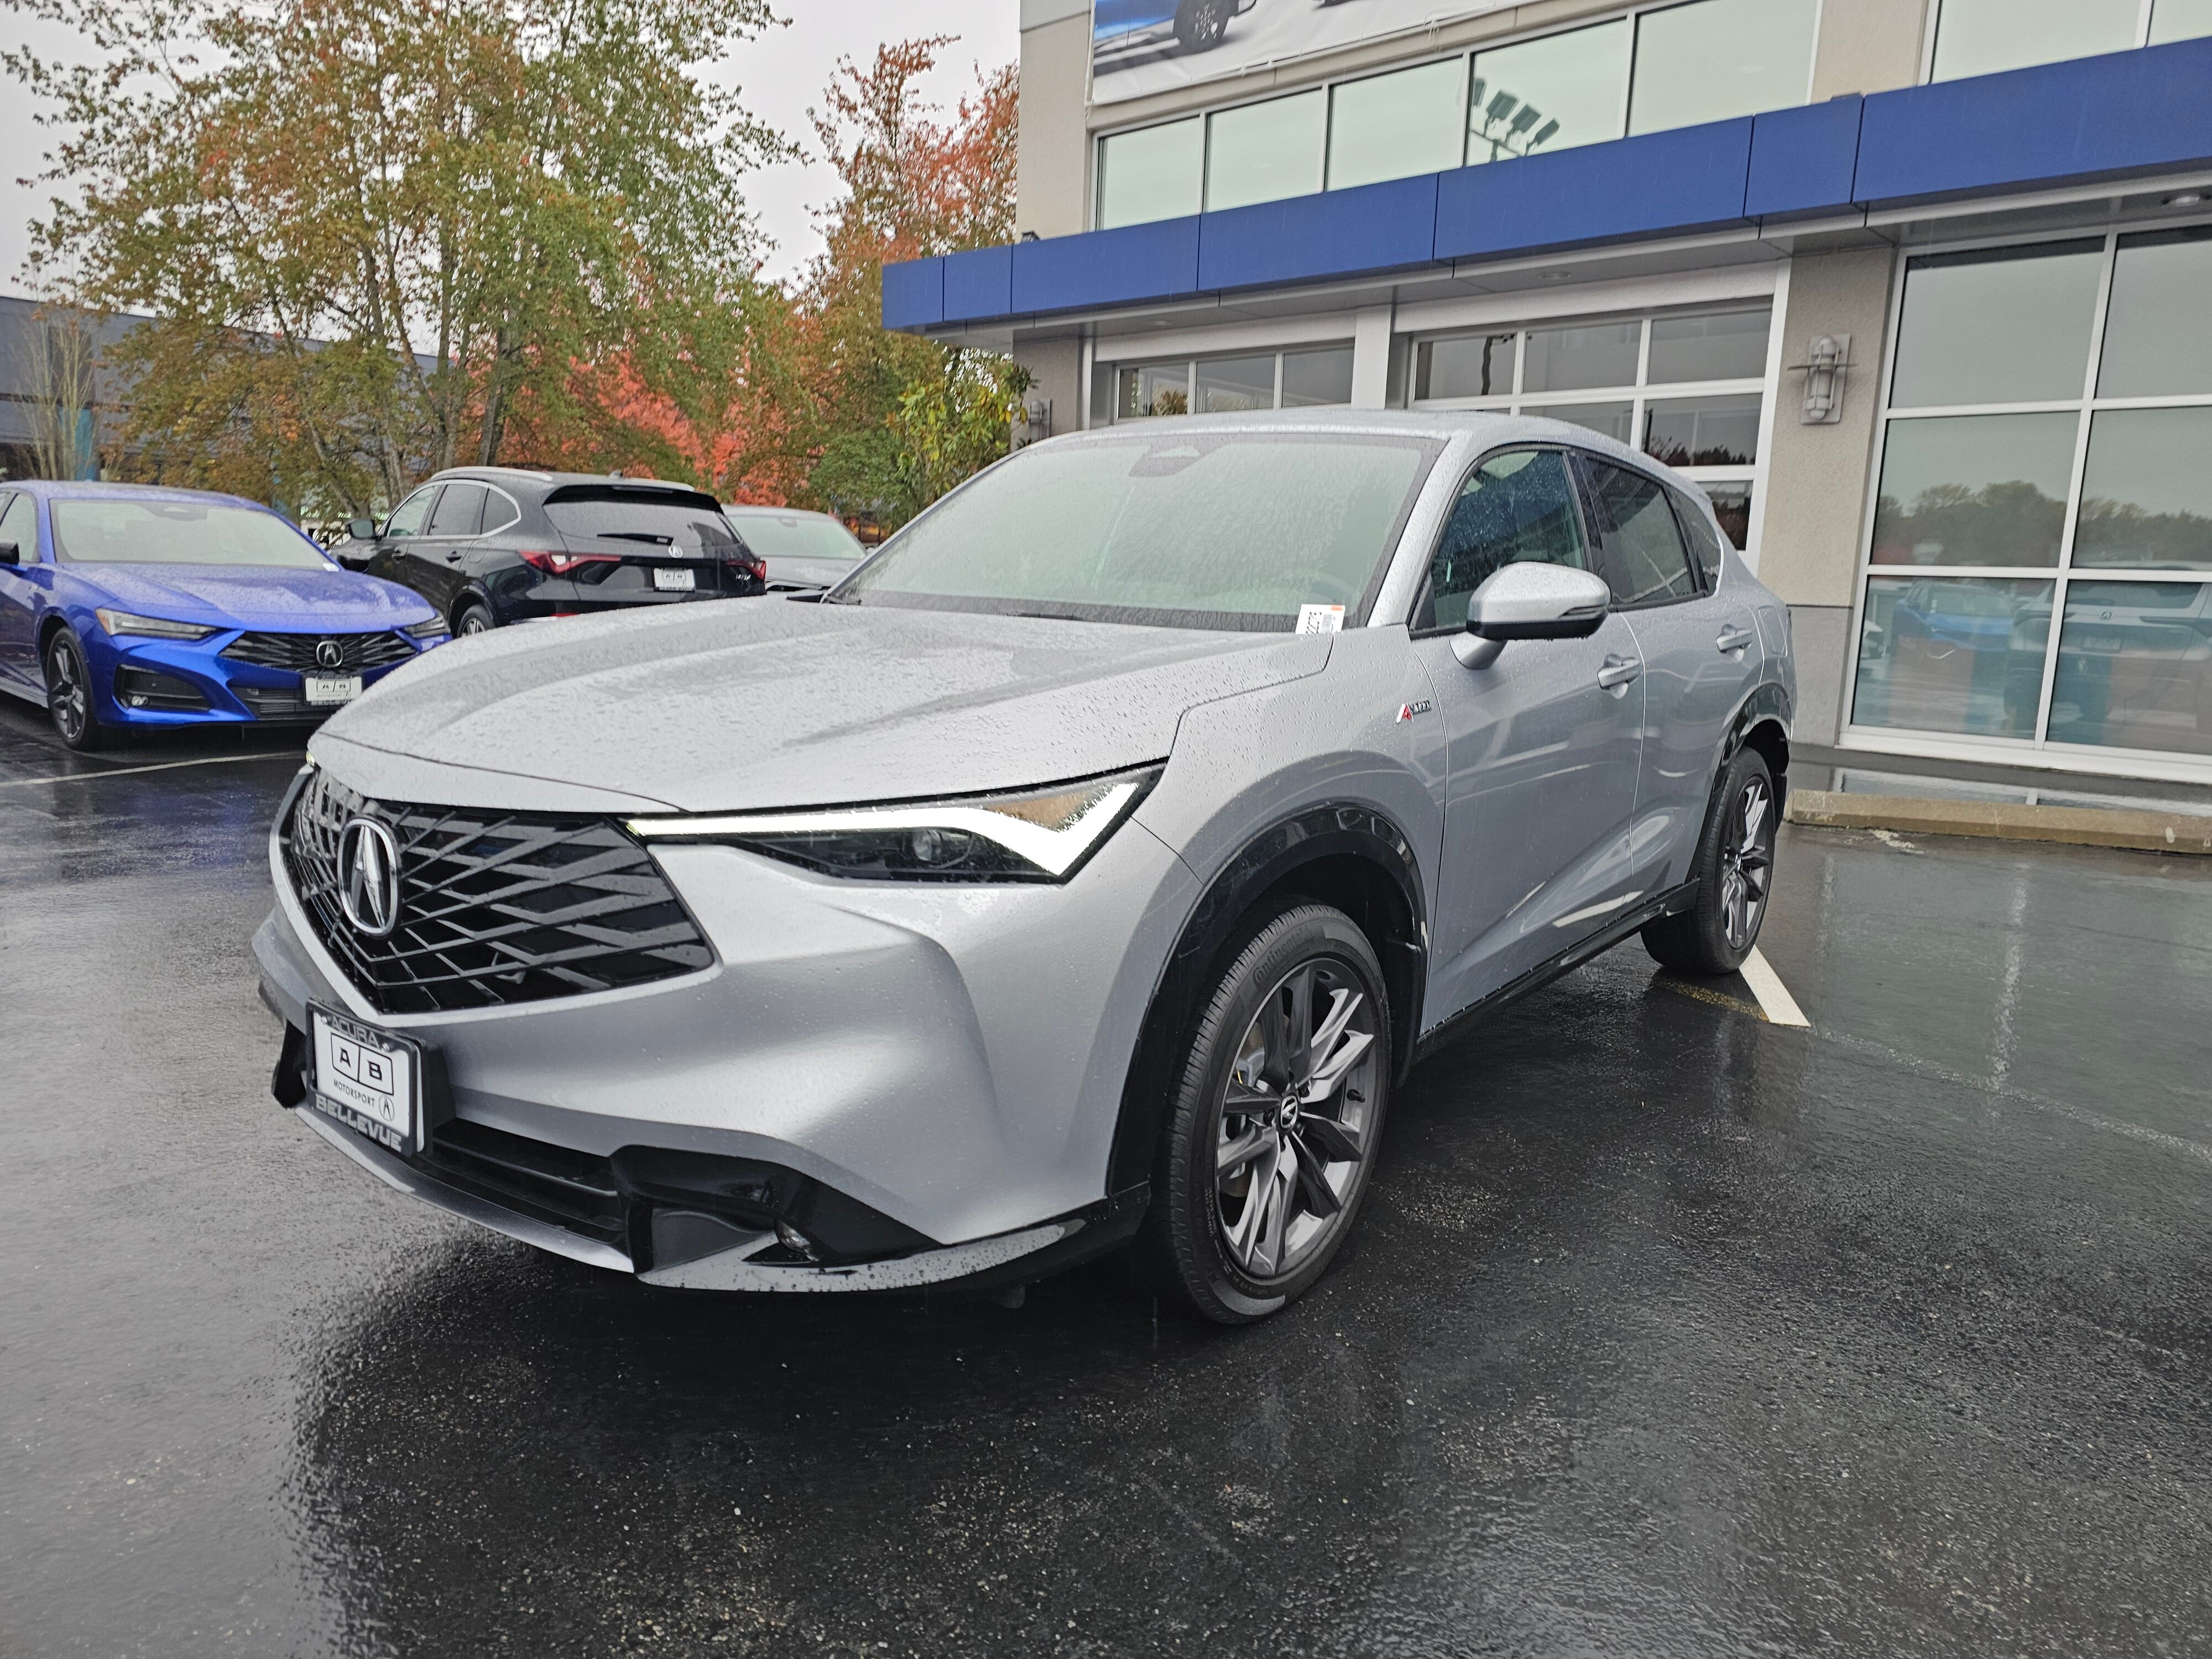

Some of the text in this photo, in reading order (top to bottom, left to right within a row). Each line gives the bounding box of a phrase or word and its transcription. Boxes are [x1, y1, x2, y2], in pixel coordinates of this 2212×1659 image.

[332, 1016, 379, 1048] ACURA
[339, 1047, 383, 1081] A B
[333, 1079, 375, 1107] MOTORSPORT
[316, 1093, 403, 1152] BELLEVUE
